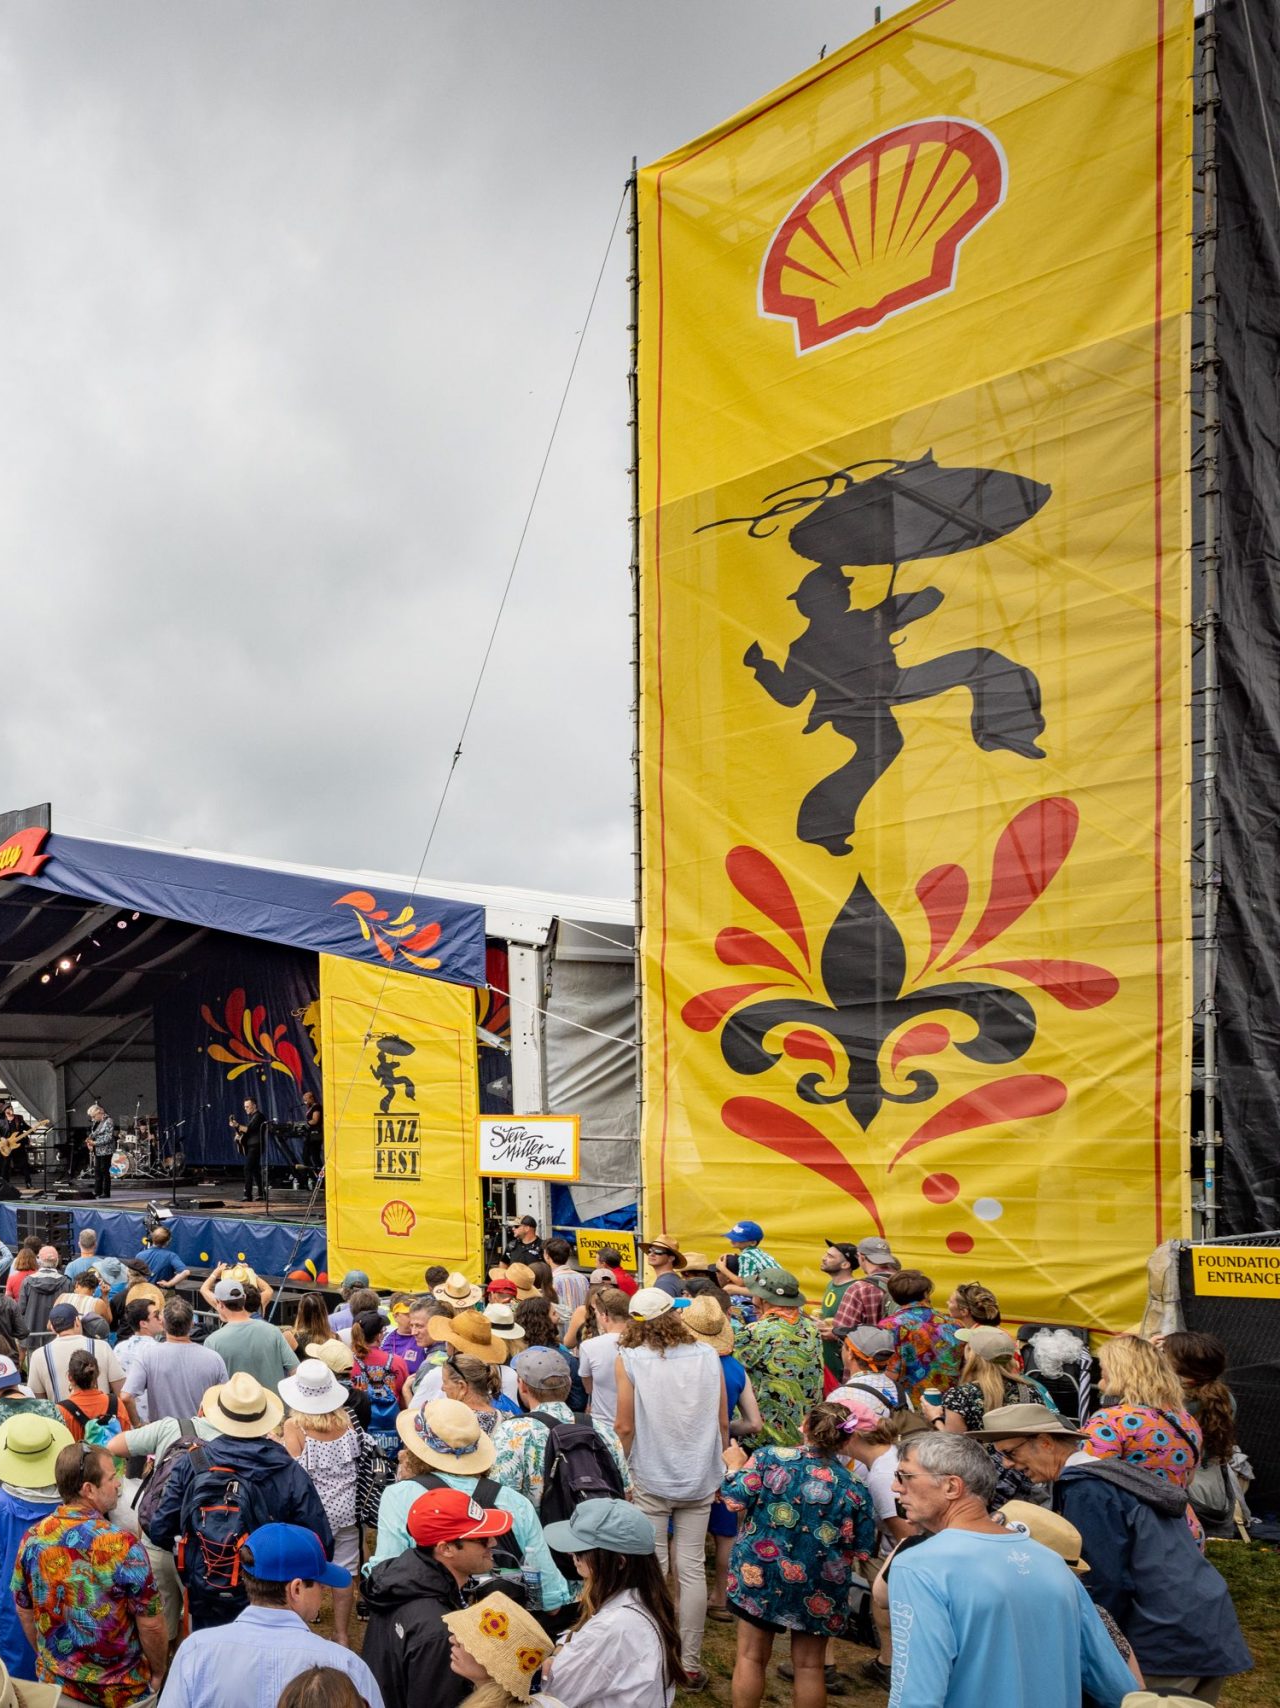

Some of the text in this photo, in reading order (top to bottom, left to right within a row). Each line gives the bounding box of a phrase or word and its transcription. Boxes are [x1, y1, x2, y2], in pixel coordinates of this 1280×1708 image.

[375, 1119, 419, 1146] JAZZ
[489, 1125, 543, 1148] Steve
[492, 1138, 554, 1162] Miller
[525, 1148, 566, 1171] Band
[376, 1149, 420, 1175] FEST
[1198, 1255, 1280, 1269] FOUNDATIO
[1207, 1271, 1280, 1285] ENTRANCE
